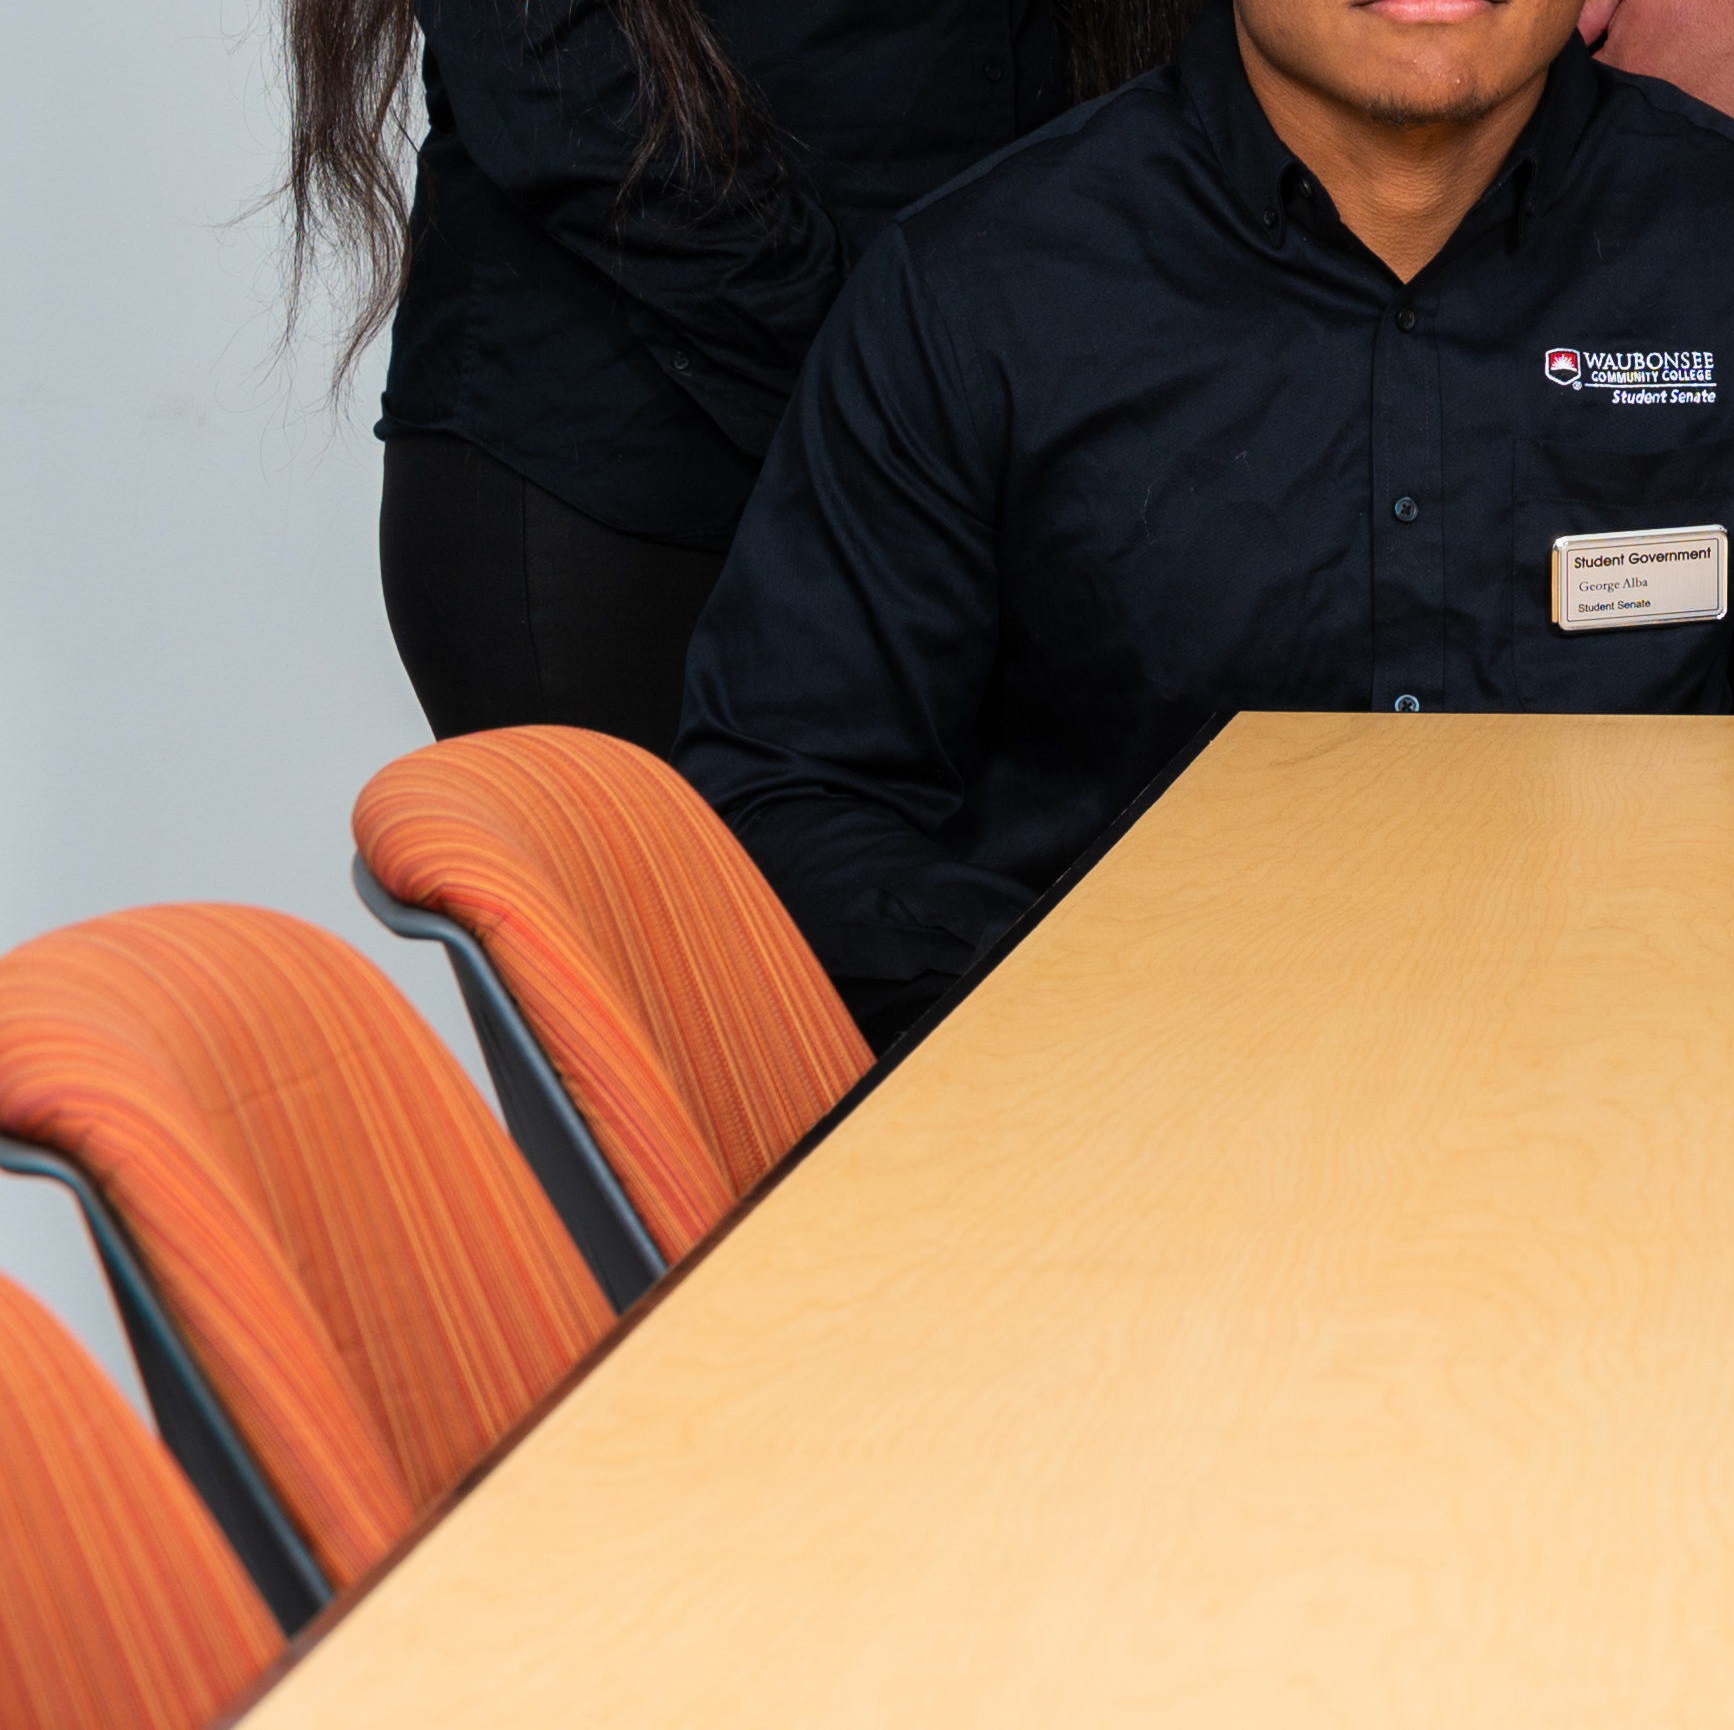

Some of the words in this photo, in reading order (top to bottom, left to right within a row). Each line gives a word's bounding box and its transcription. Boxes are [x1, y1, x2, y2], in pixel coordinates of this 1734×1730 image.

[1583, 352, 1714, 370] WAUBONSEE
[1591, 370, 1658, 383] COMMUNITY
[1662, 370, 1712, 381] COLLEGE
[1612, 389, 1668, 404] Student
[1670, 390, 1716, 404] Senate
[1574, 554, 1625, 569] Student
[1629, 547, 1712, 564] Government
[1579, 580, 1620, 593] George
[1623, 577, 1648, 589] Alba
[1578, 602, 1615, 613] Student
[1618, 599, 1651, 610] Senate
